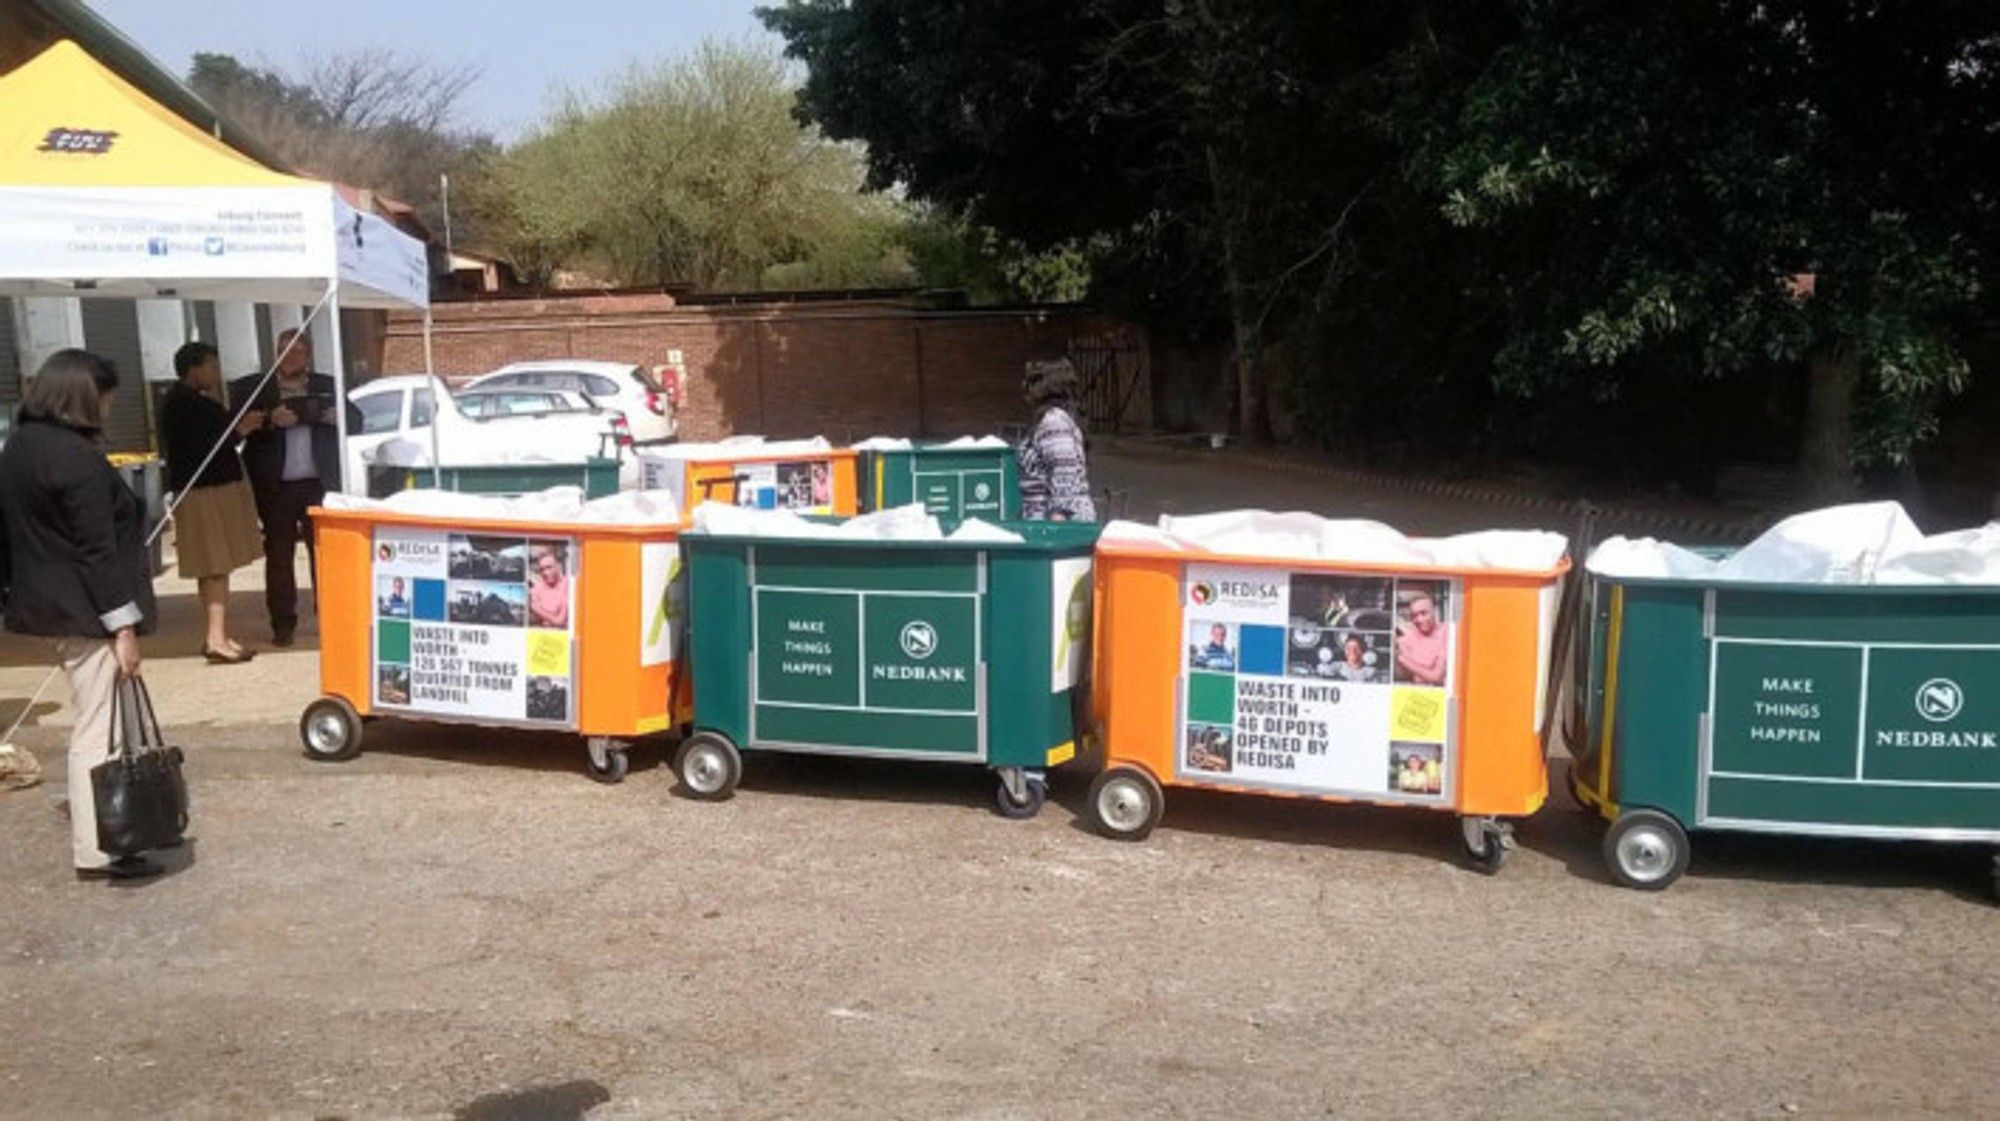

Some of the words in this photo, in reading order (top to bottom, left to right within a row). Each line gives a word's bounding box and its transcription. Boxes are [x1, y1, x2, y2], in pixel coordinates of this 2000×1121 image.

[1221, 581, 1279, 598] REDISA
[788, 619, 825, 634] MAKE
[413, 627, 455, 643] WASTE
[459, 630, 490, 645] INTO
[413, 643, 459, 656] WORTH
[784, 641, 832, 655] THINGS
[468, 660, 519, 676] TONNES
[782, 661, 833, 676] HAPPEN
[872, 664, 967, 683] NEDBANK
[413, 671, 472, 687] DIVERTED
[475, 674, 513, 690] FROM
[1762, 677, 1814, 694] MAKE
[413, 686, 468, 702] LANDFILL
[1237, 680, 1295, 699] WASTE
[1301, 685, 1341, 704] INTO
[1237, 698, 1298, 718] WORTH
[1754, 702, 1820, 719] THINGS
[1237, 715, 1258, 732] 46
[1263, 717, 1328, 738] DEPOTS
[1751, 726, 1821, 743] HAPPEN
[1237, 732, 1302, 753] OPENED
[1307, 739, 1329, 756] BY
[1876, 730, 1997, 748] NEDBANK
[1237, 751, 1296, 769] REDISA
